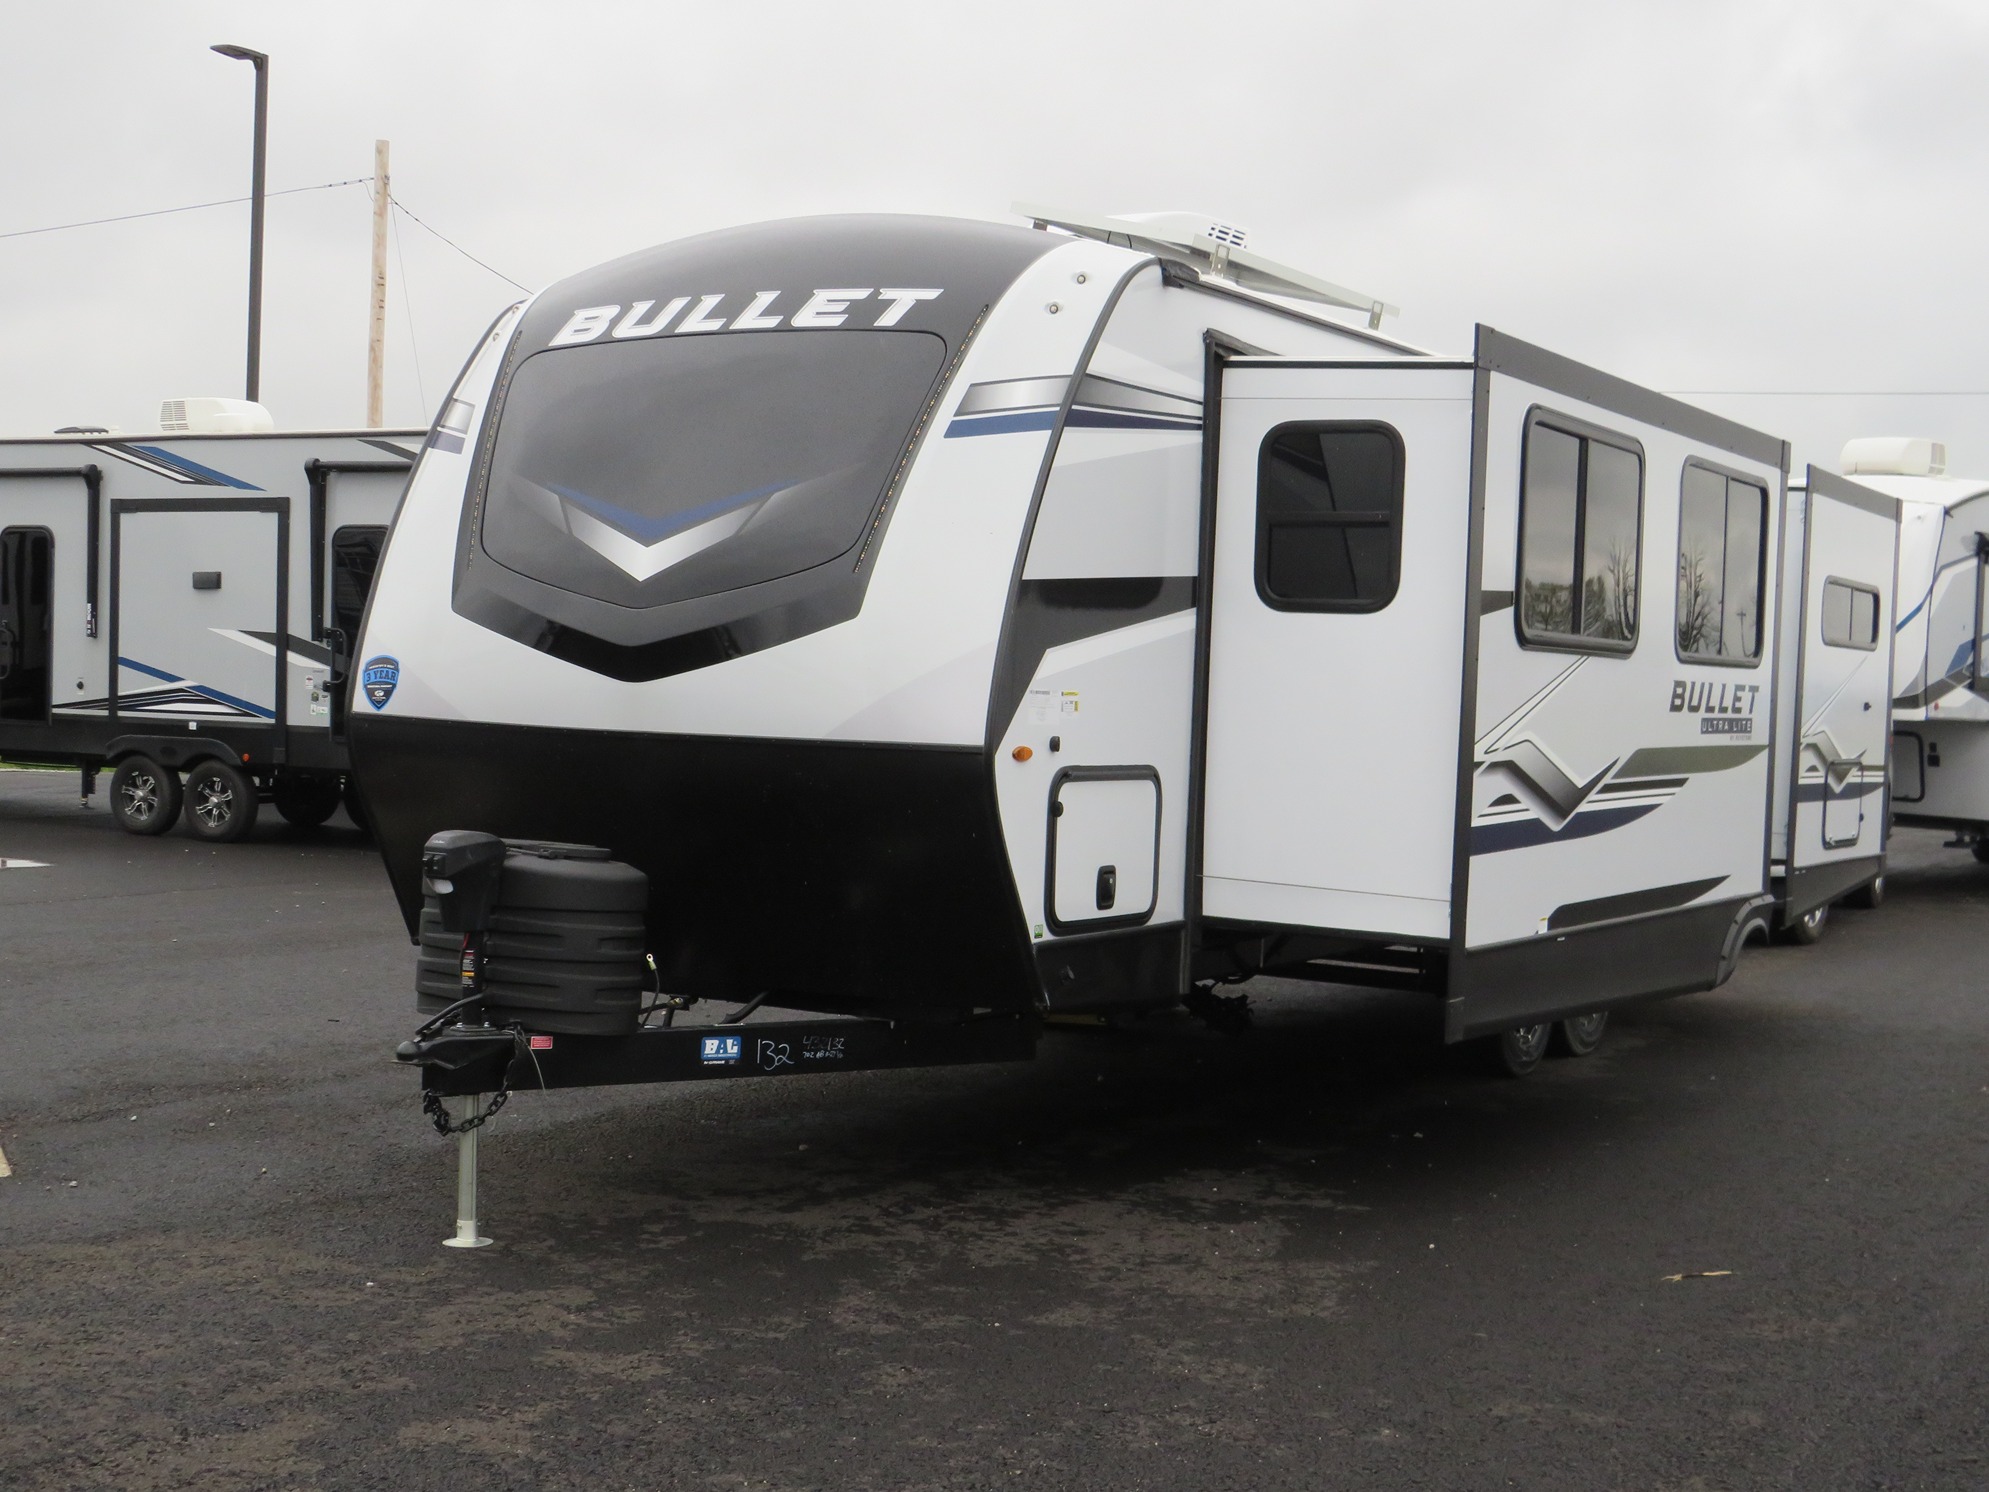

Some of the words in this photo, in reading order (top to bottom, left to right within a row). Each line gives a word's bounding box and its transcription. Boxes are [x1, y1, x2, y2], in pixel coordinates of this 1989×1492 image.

[548, 288, 944, 346] BULLET
[374, 669, 397, 682] YEAR
[1669, 680, 1760, 715] BULLET
[1702, 720, 1729, 732] ULTRA
[1733, 720, 1752, 732] LITE
[757, 1038, 795, 1071] 132
